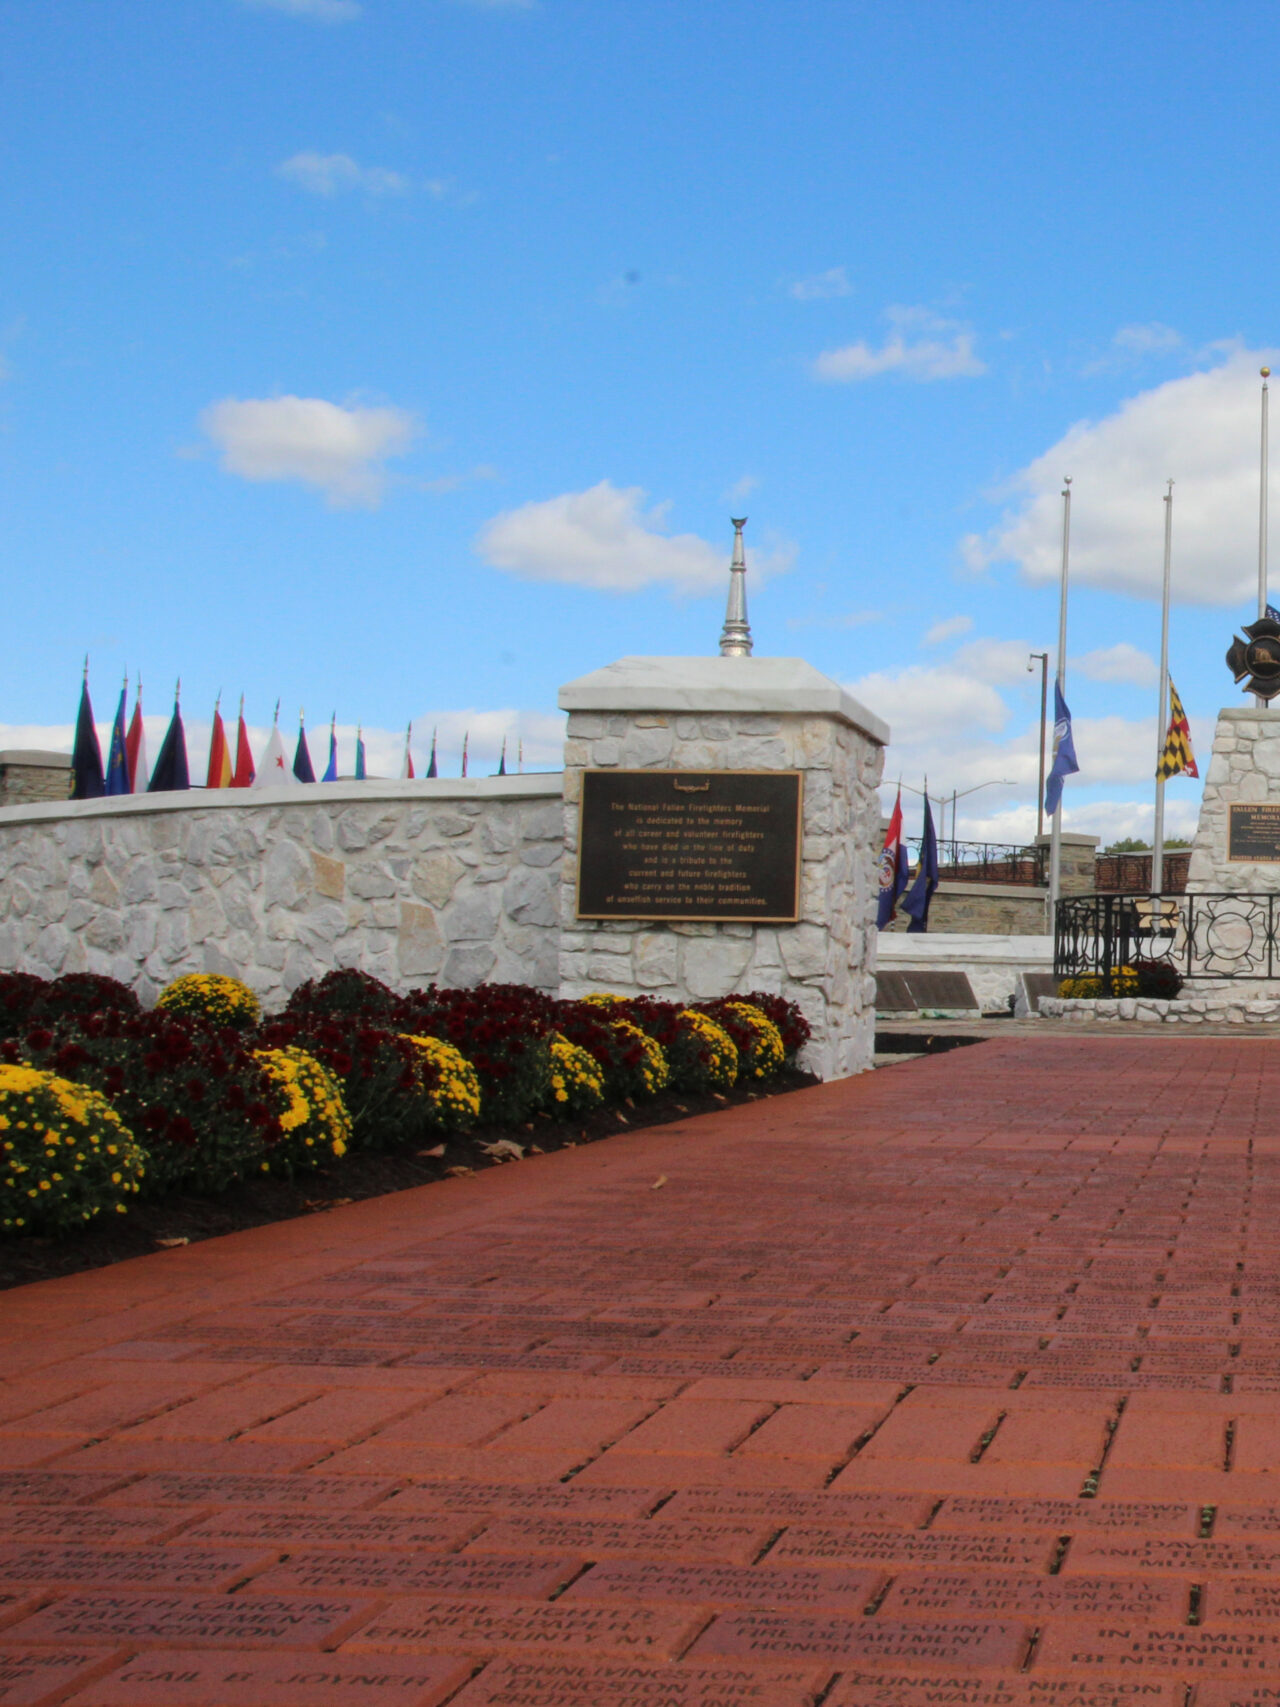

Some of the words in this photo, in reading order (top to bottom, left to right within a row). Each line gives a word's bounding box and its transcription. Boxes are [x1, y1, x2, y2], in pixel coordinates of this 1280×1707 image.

[611, 803, 624, 811] The
[629, 803, 659, 812] National
[663, 804, 684, 812] Fallen
[689, 804, 731, 813] Firefighters
[722, 832, 764, 840] firefighters
[705, 871, 747, 879] firefighters
[65, 1598, 185, 1609] SOUTH
[191, 1599, 352, 1613] CAROLINA
[54, 1623, 288, 1638] ASSOCIATION
[119, 1670, 202, 1683] GAIL
